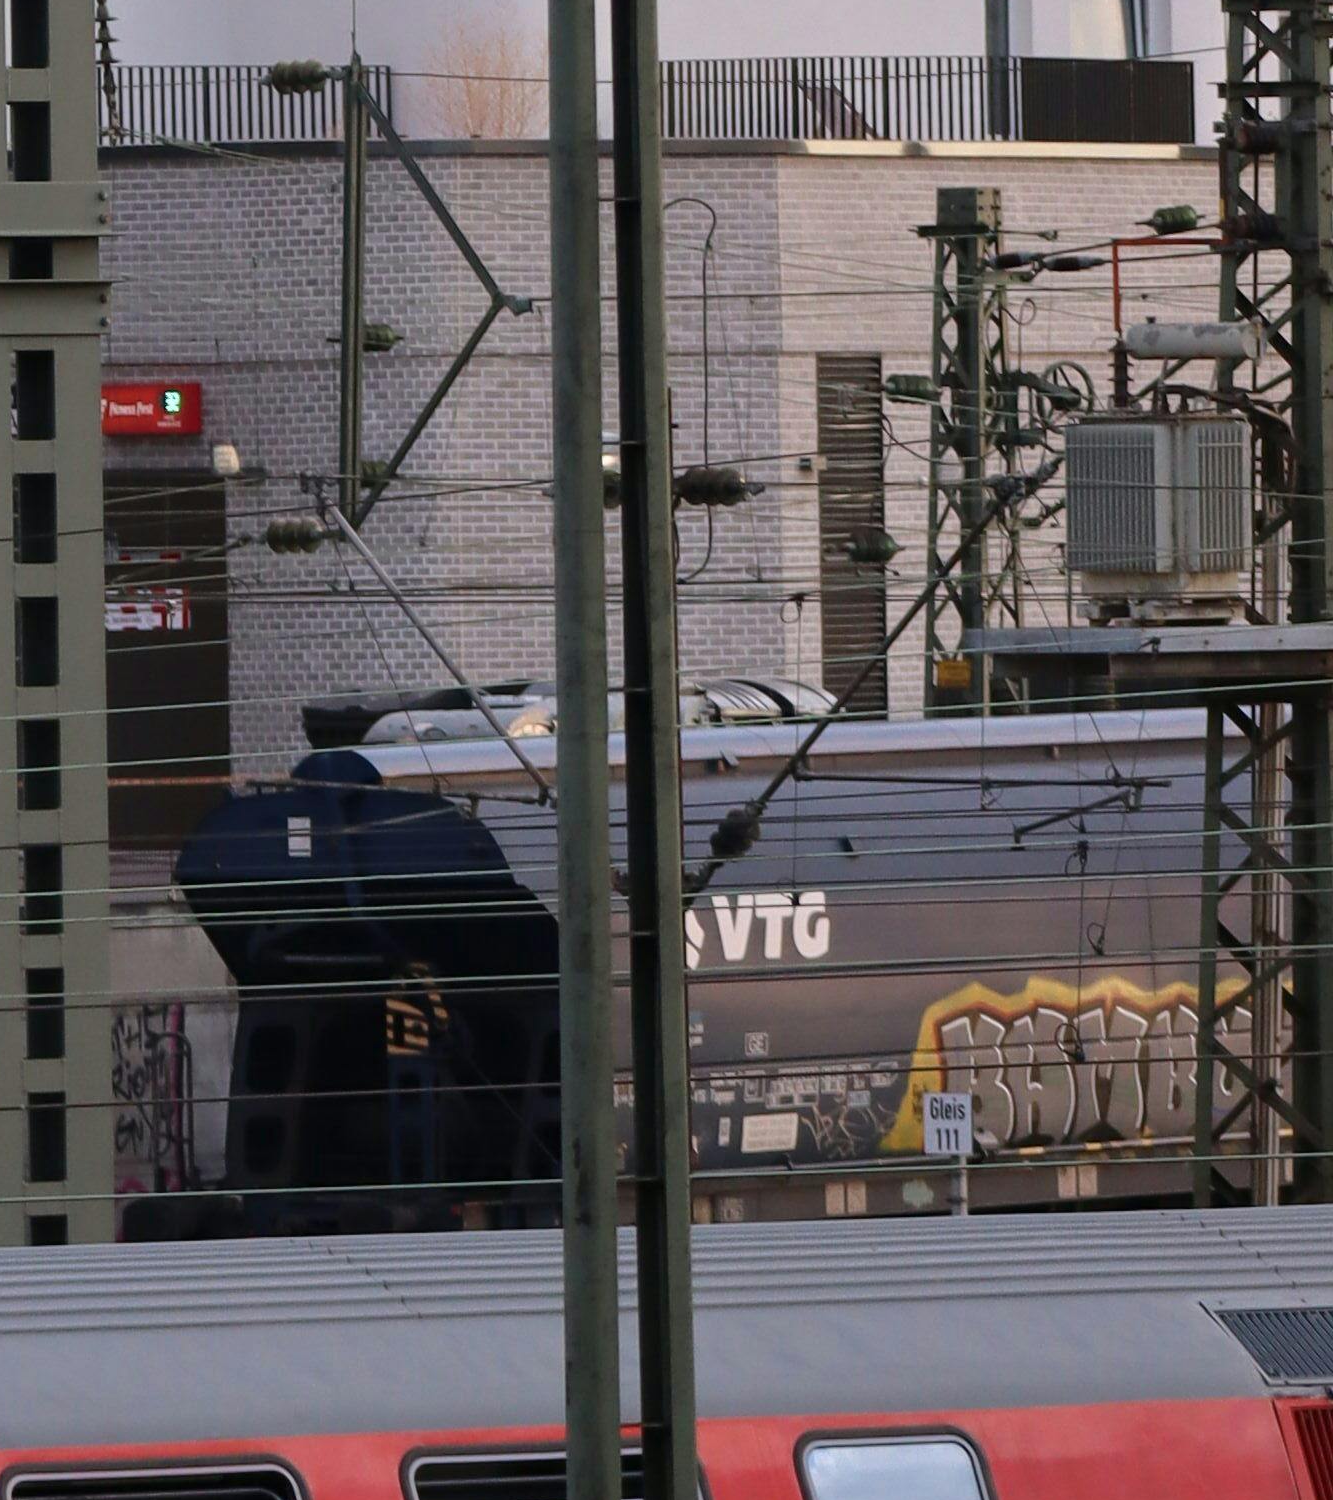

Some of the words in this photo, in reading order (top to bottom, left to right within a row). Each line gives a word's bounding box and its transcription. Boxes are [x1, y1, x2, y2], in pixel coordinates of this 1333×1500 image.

[711, 890, 831, 962] VTG
[929, 1096, 966, 1120] Gleis
[936, 1128, 960, 1151] 111
